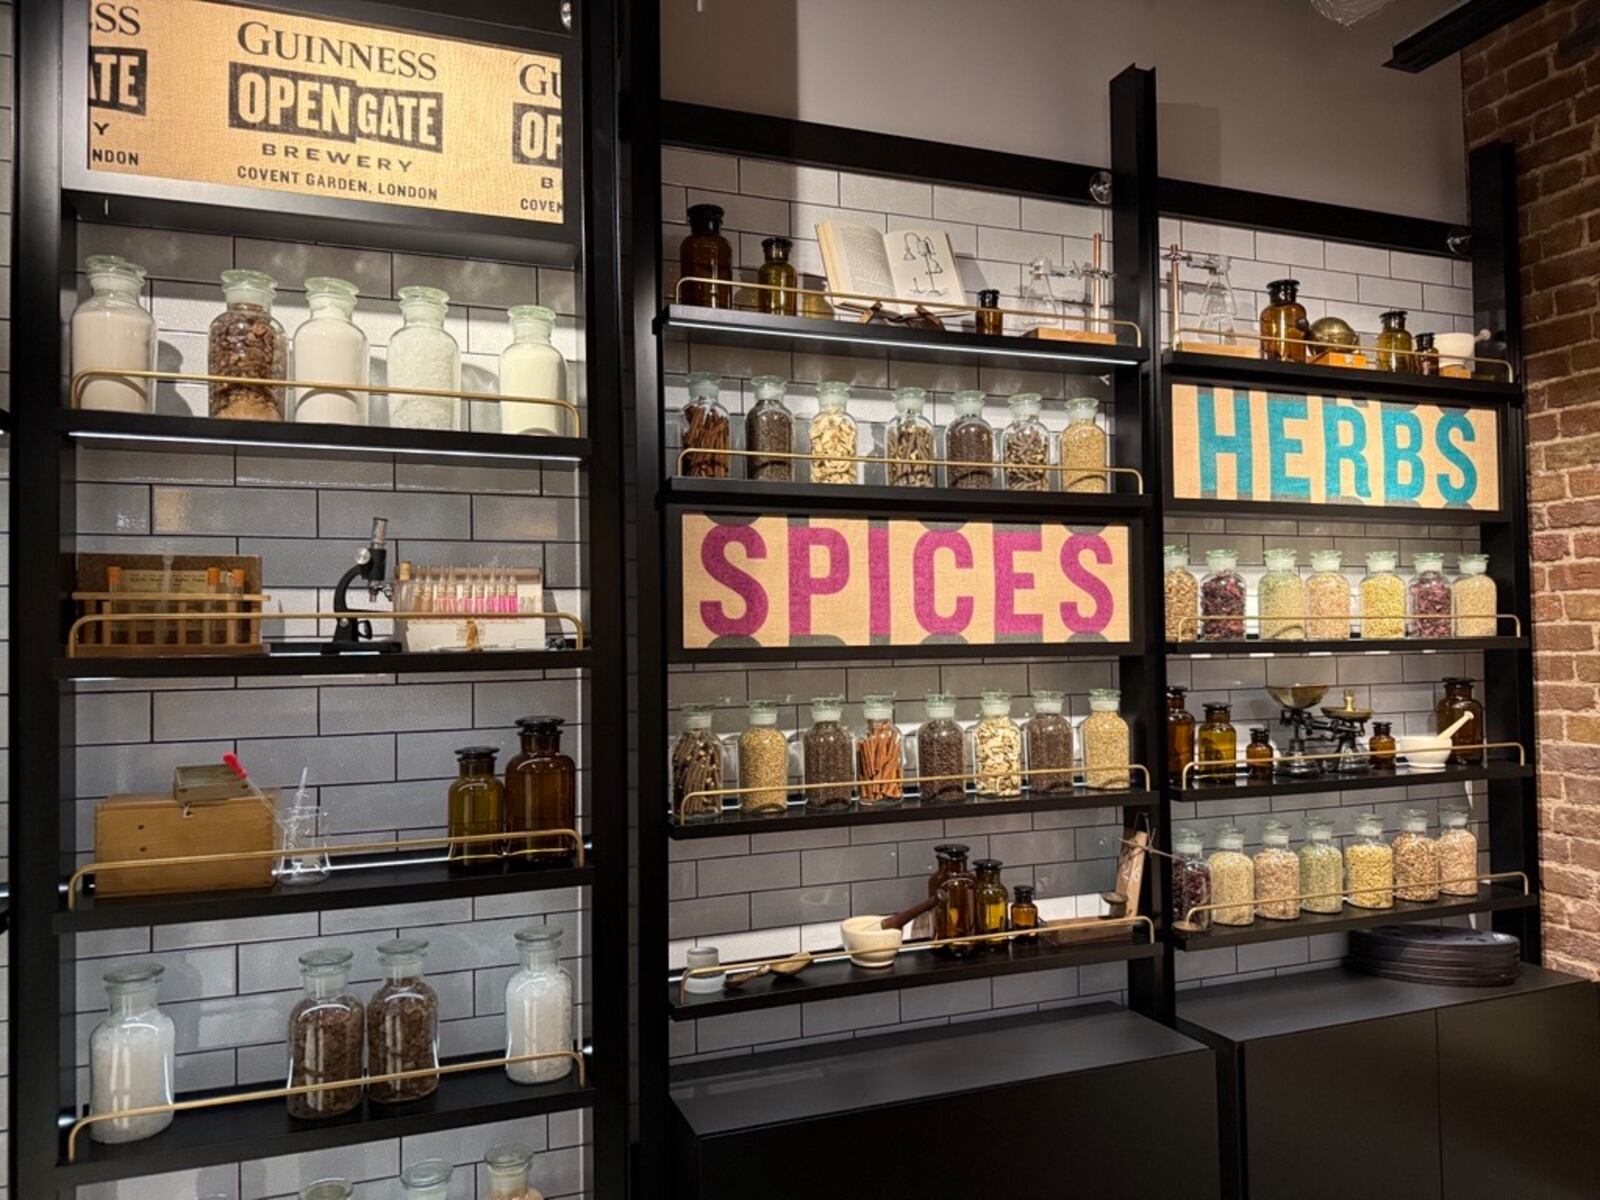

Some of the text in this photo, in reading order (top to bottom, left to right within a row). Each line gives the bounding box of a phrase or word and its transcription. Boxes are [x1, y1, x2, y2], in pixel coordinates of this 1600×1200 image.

[237, 21, 437, 81] GUINNESS
[238, 71, 437, 145] OPEN GATE
[237, 165, 300, 184] COVENT
[378, 183, 438, 200] LONDON
[262, 143, 413, 173] BREWERY
[1197, 394, 1478, 504] HERBS
[700, 523, 1114, 636] SPICES
